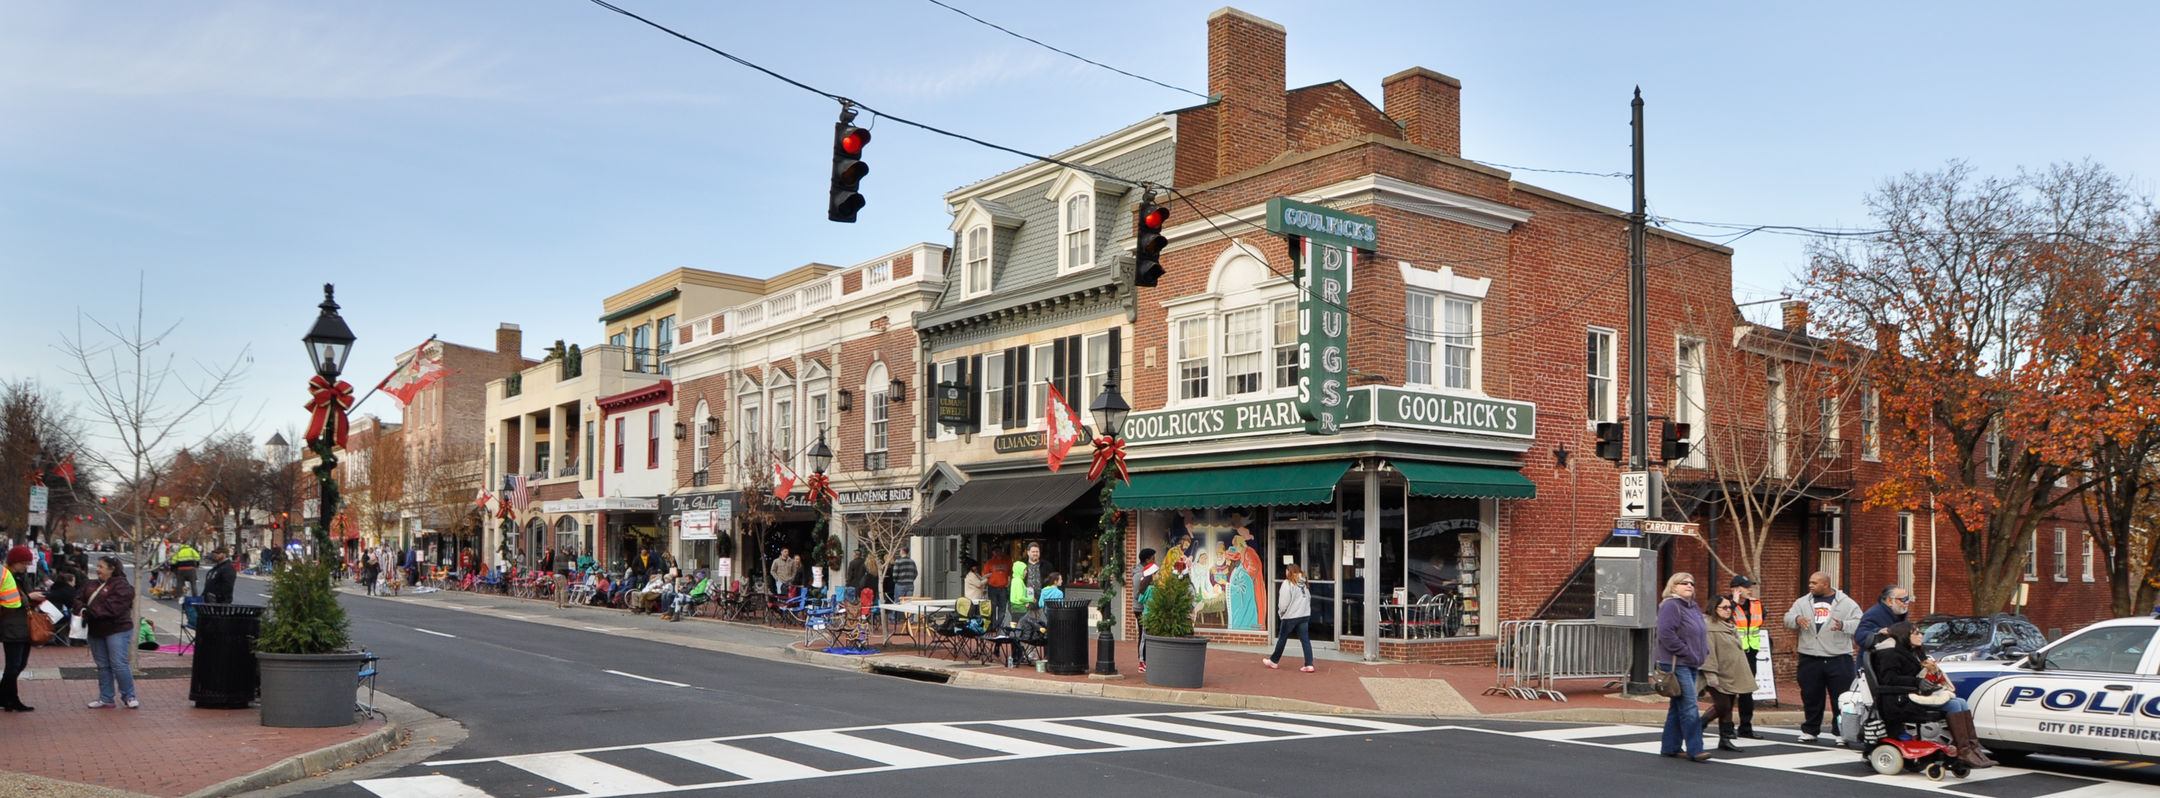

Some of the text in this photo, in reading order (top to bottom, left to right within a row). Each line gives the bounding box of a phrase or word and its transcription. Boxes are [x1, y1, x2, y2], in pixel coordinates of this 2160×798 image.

[1284, 207, 1376, 242] GOOLRICK'S
[1299, 252, 1311, 404] RUGS
[1321, 244, 1342, 407] DRUGS
[1398, 395, 1517, 430] GOOLRICK'S
[1124, 408, 1224, 440] GOOLRICK'S
[996, 434, 1038, 450] ULMAN'S
[1624, 476, 1644, 487] ONE
[838, 493, 851, 504] AVA
[889, 488, 911, 501] BRIDE
[1625, 489, 1644, 499] WAY
[672, 497, 689, 511] The
[692, 495, 718, 510] Galle
[1645, 522, 1684, 534] CAROLINE
[2038, 721, 2065, 733] CITY
[2069, 724, 2084, 735] OF
